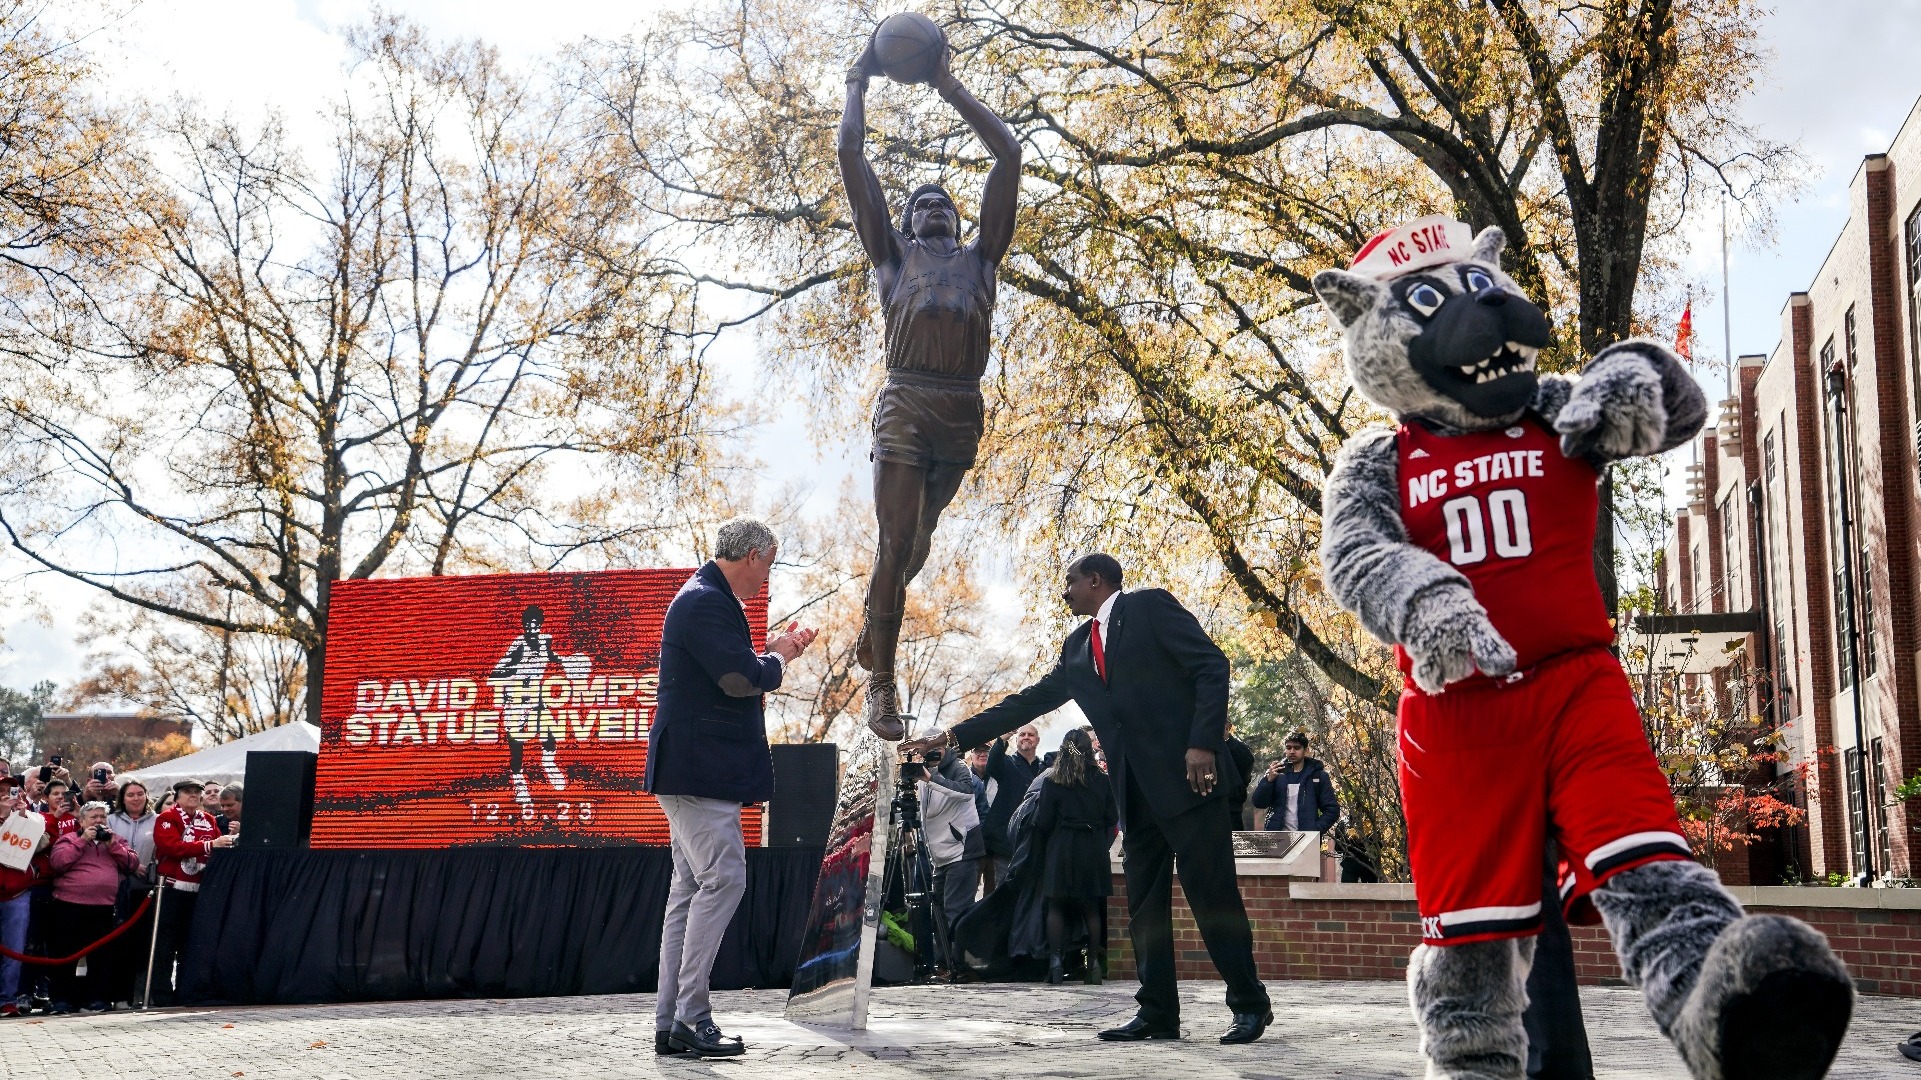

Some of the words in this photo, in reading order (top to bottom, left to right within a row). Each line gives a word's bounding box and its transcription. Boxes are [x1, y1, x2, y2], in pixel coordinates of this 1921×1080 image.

[1387, 240, 1410, 267] NC
[1408, 468, 1448, 508] NC
[1454, 450, 1544, 488] STATE
[1442, 488, 1532, 566] 00
[356, 678, 478, 711] DAVID
[486, 673, 659, 709] THOMPS
[345, 710, 500, 745] STATUE
